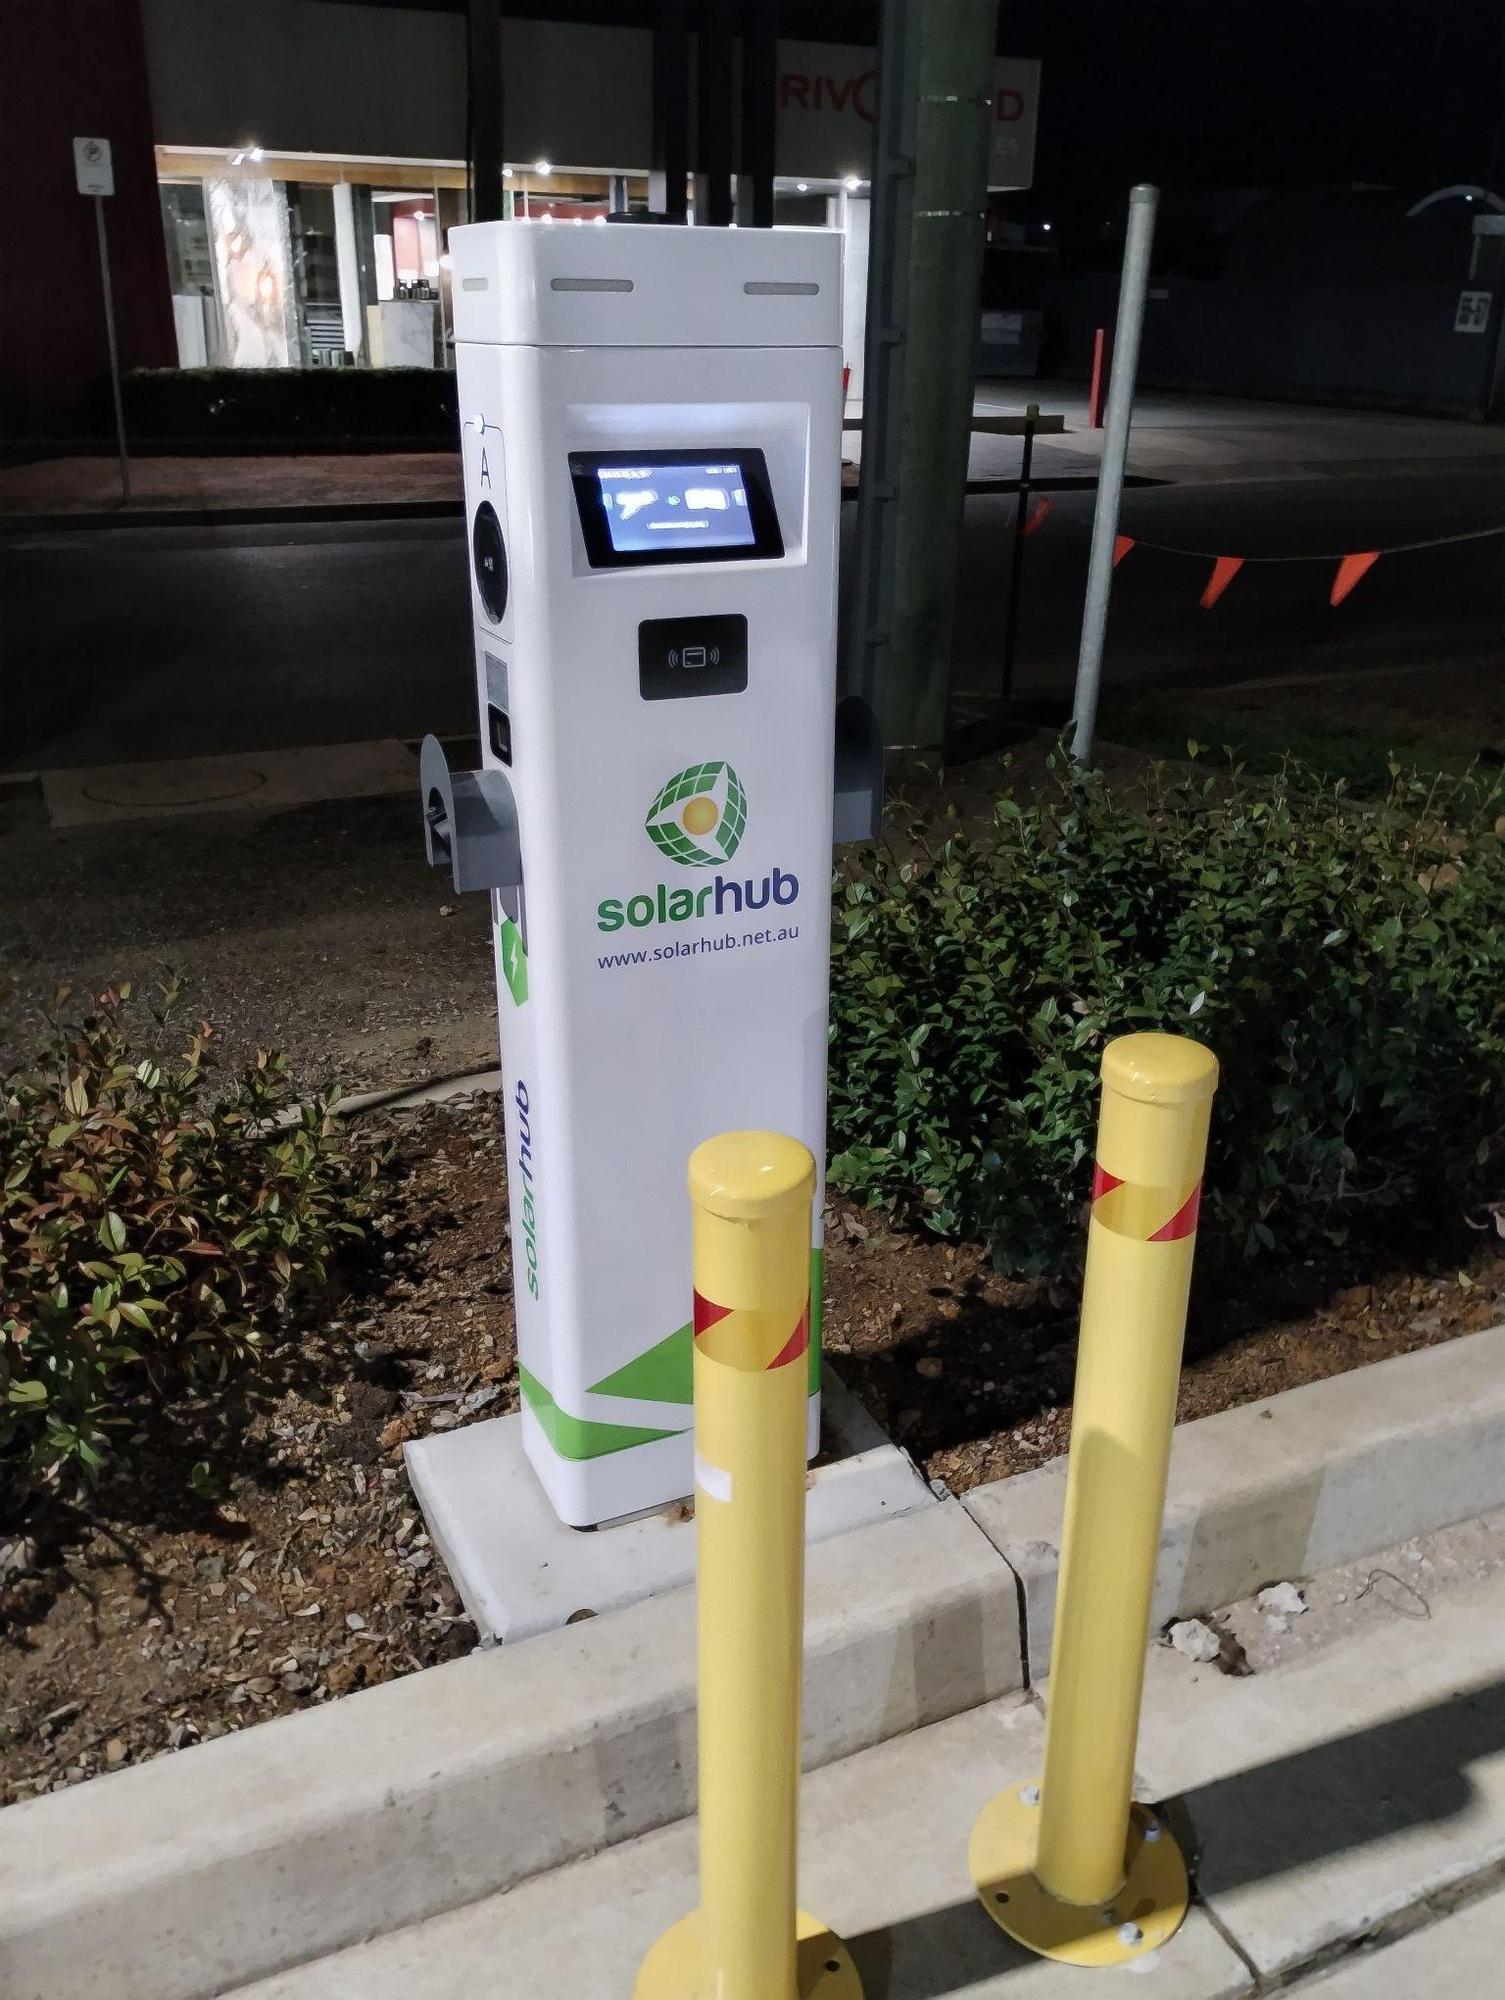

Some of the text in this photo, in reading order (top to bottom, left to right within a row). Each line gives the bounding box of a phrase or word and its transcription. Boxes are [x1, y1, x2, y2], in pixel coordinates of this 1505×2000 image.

[481, 446, 491, 490] A
[597, 867, 799, 932] solarhub
[597, 926, 799, 969] www.solarhub.net.au
[515, 1079, 539, 1301] solarhub
